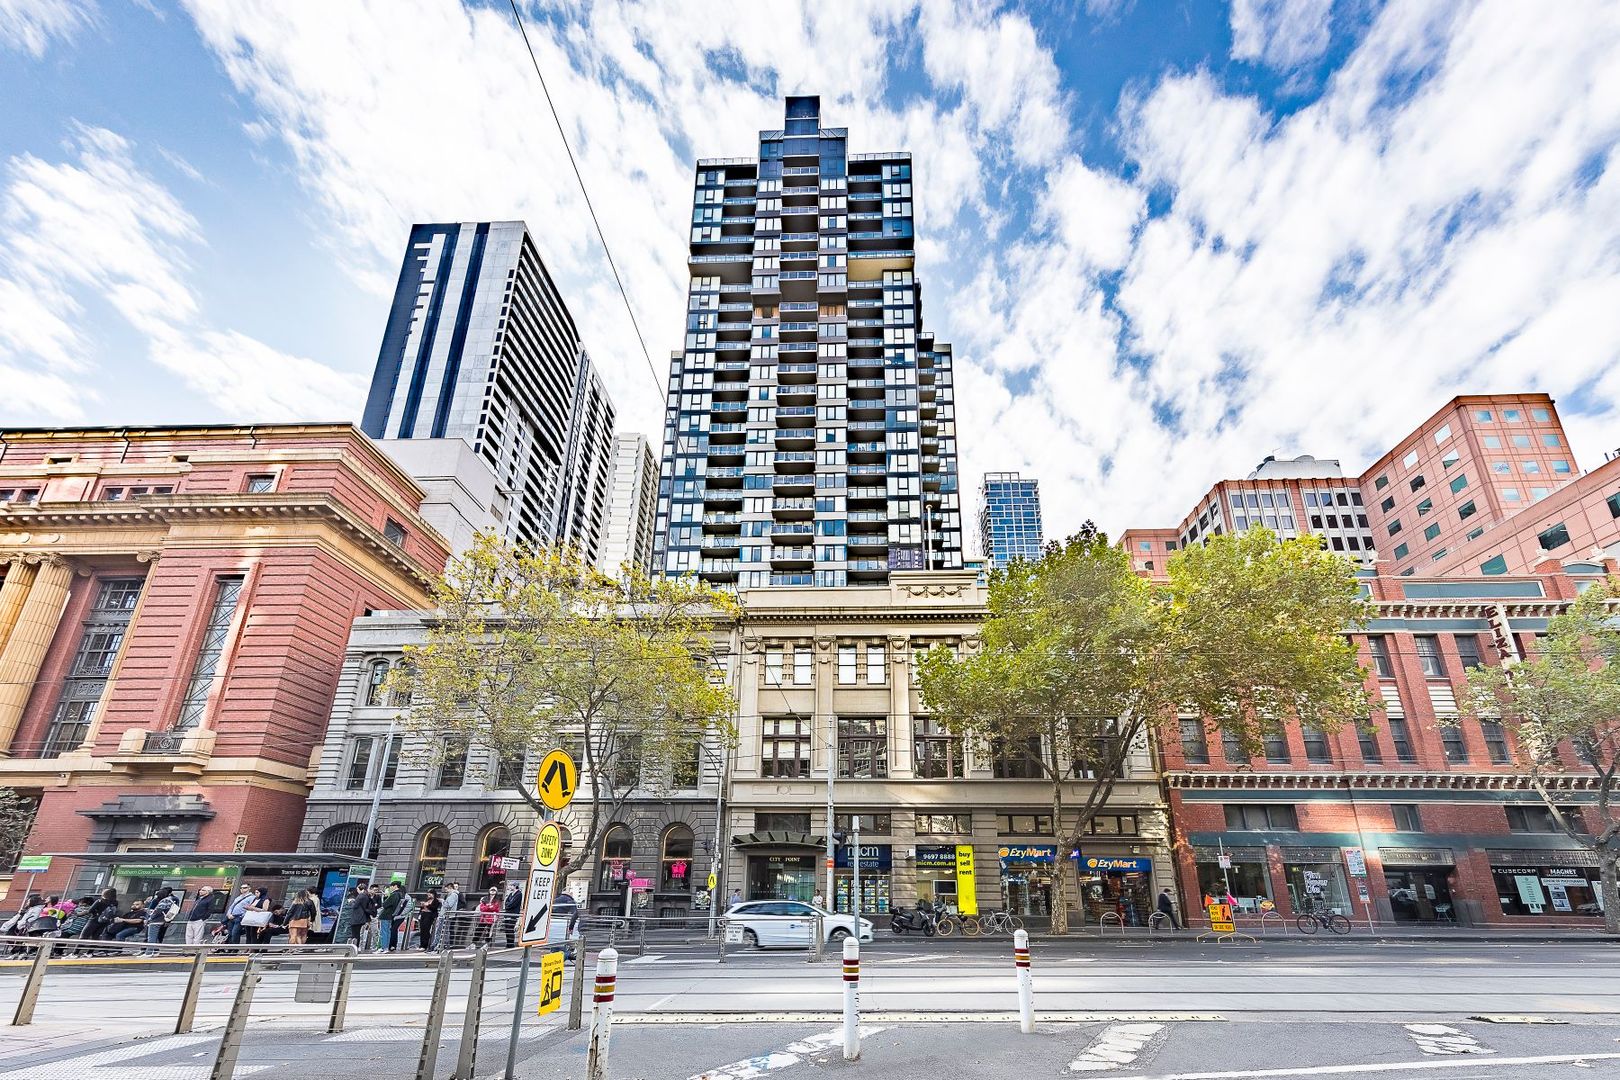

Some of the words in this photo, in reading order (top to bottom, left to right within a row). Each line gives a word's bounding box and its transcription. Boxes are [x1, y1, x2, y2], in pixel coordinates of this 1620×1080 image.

[540, 834, 557, 846] SAFETY
[541, 847, 553, 859] ZONE
[1009, 848, 1051, 858] EzyMart
[1097, 859, 1137, 870] EzyMart
[535, 877, 551, 887] KEEP
[533, 890, 548, 900] LEFT
